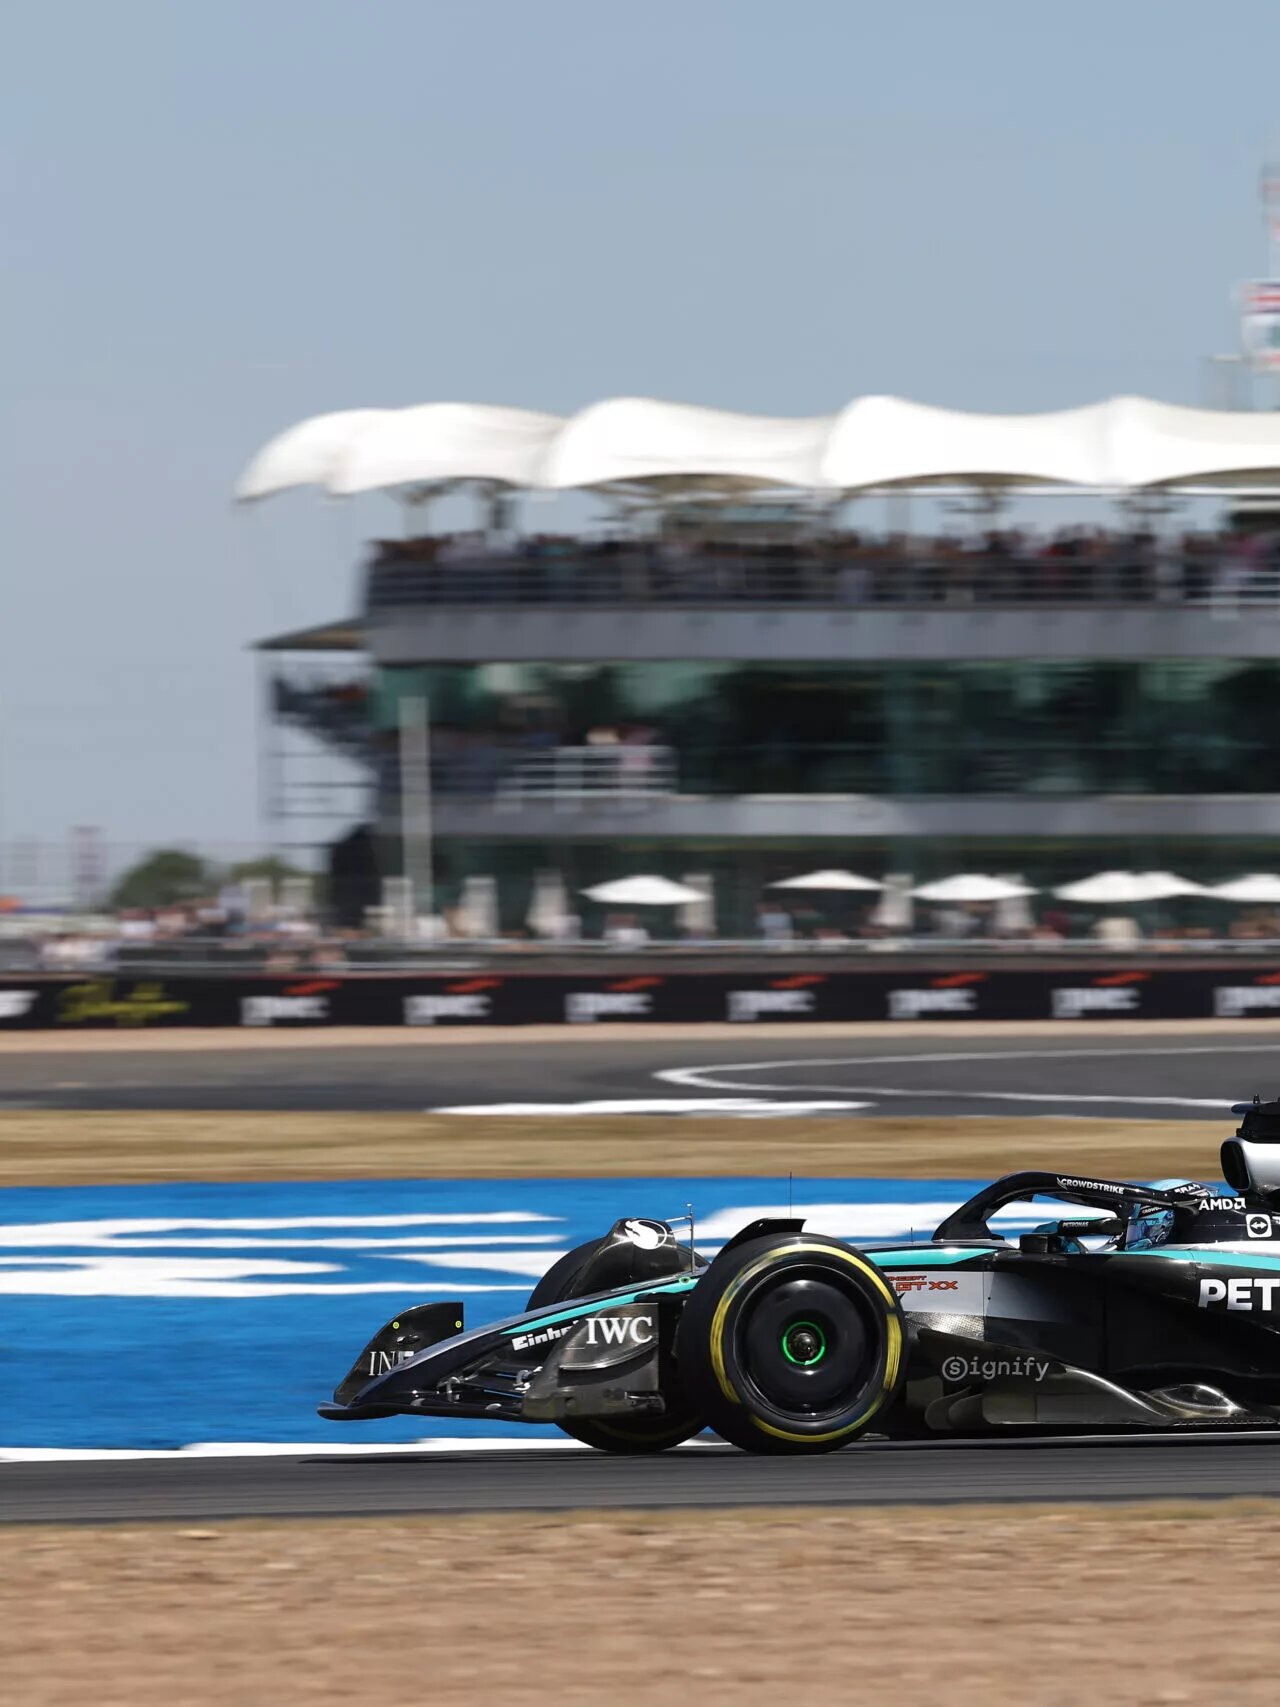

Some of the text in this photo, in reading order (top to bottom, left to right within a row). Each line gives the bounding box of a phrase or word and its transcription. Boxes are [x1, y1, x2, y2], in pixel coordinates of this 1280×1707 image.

[1061, 1178, 1125, 1195] CROWDSTRIKE
[1198, 1198, 1233, 1211] AMD
[585, 1315, 654, 1345] IWC
[941, 1355, 1051, 1383] signify
